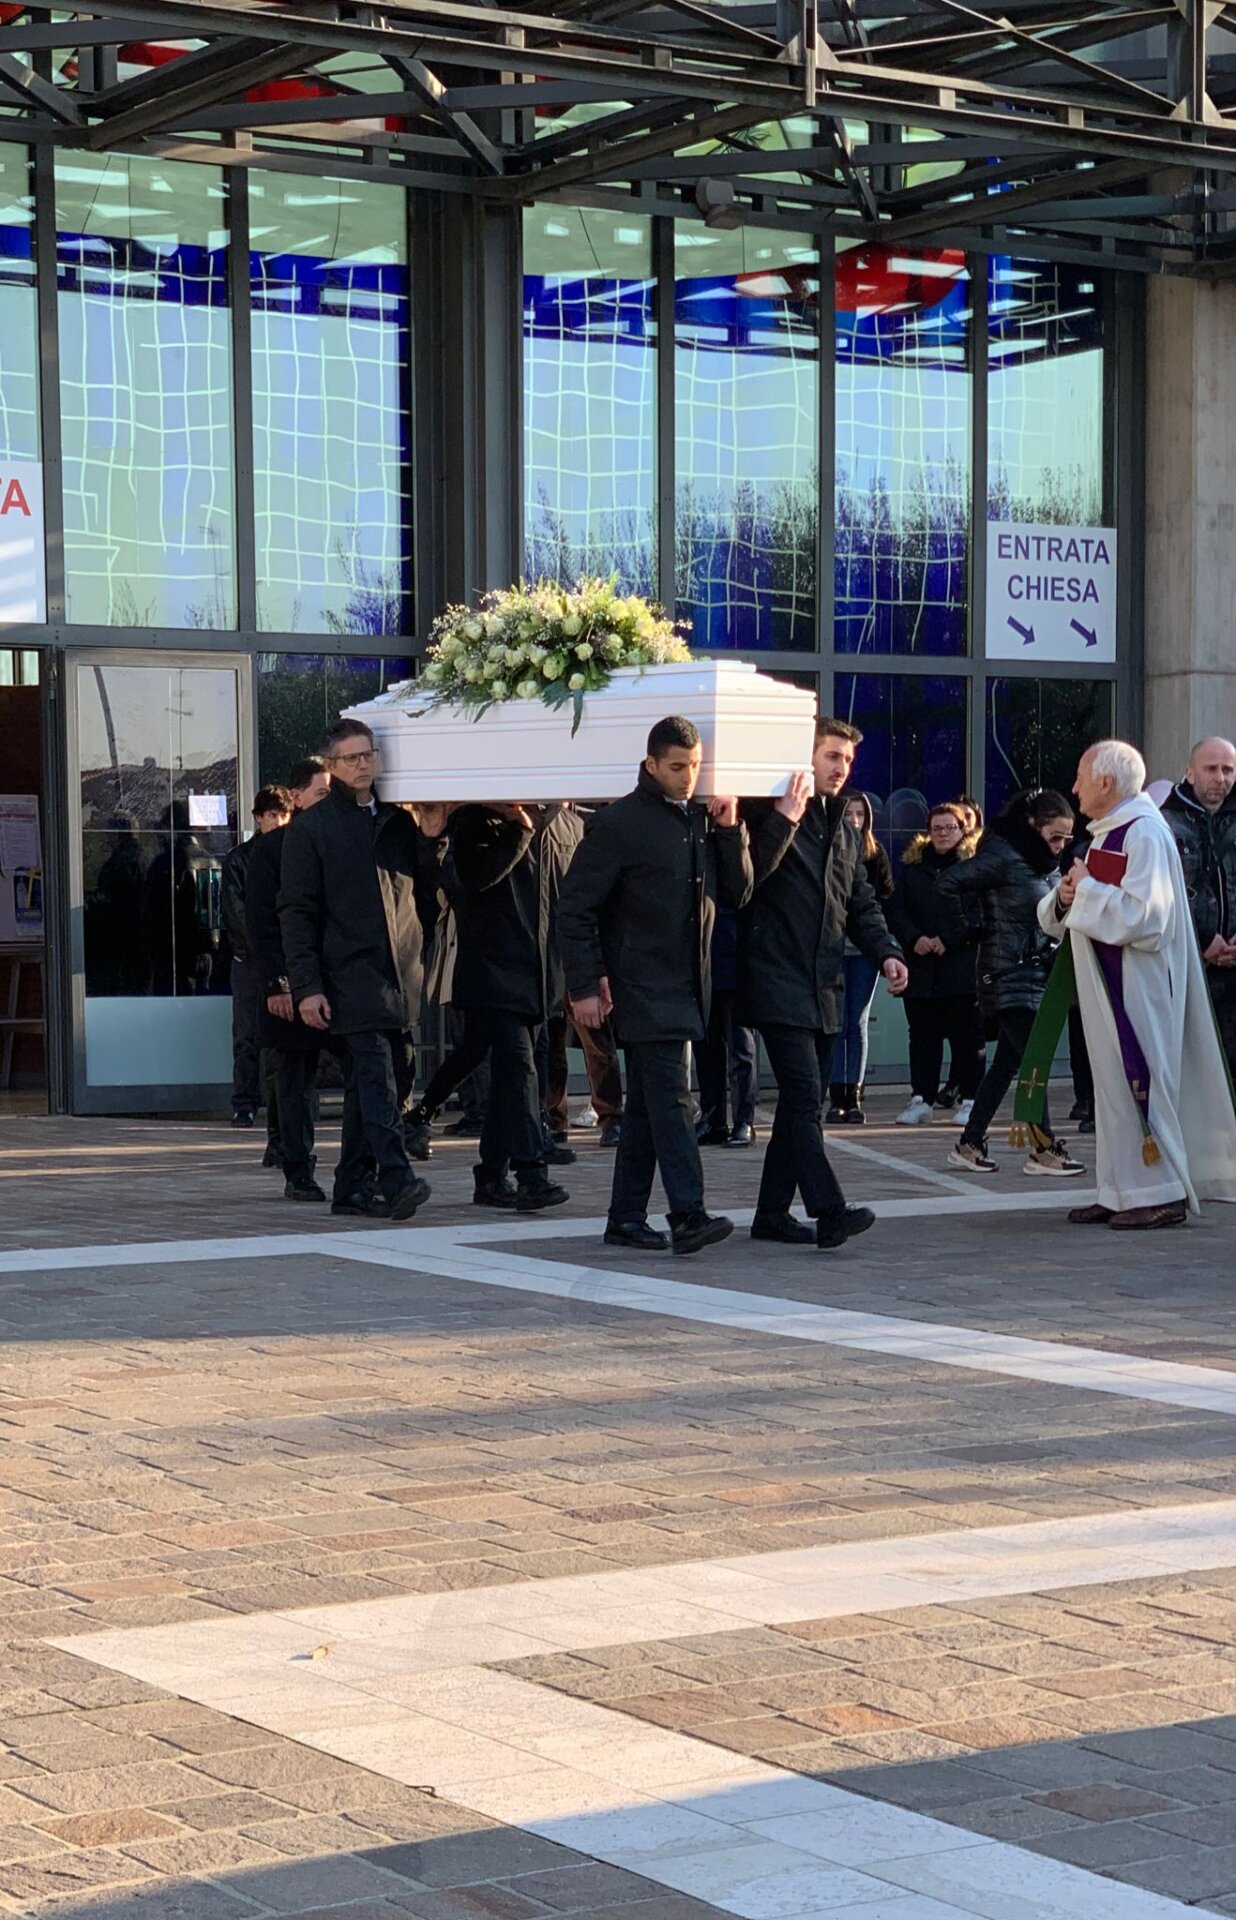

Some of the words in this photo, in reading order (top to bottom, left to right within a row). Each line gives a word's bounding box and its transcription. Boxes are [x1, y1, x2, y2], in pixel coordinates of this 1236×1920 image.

[0, 478, 31, 516] A
[998, 534, 1110, 564] ENTRATA
[1007, 574, 1100, 603] CHIESA
